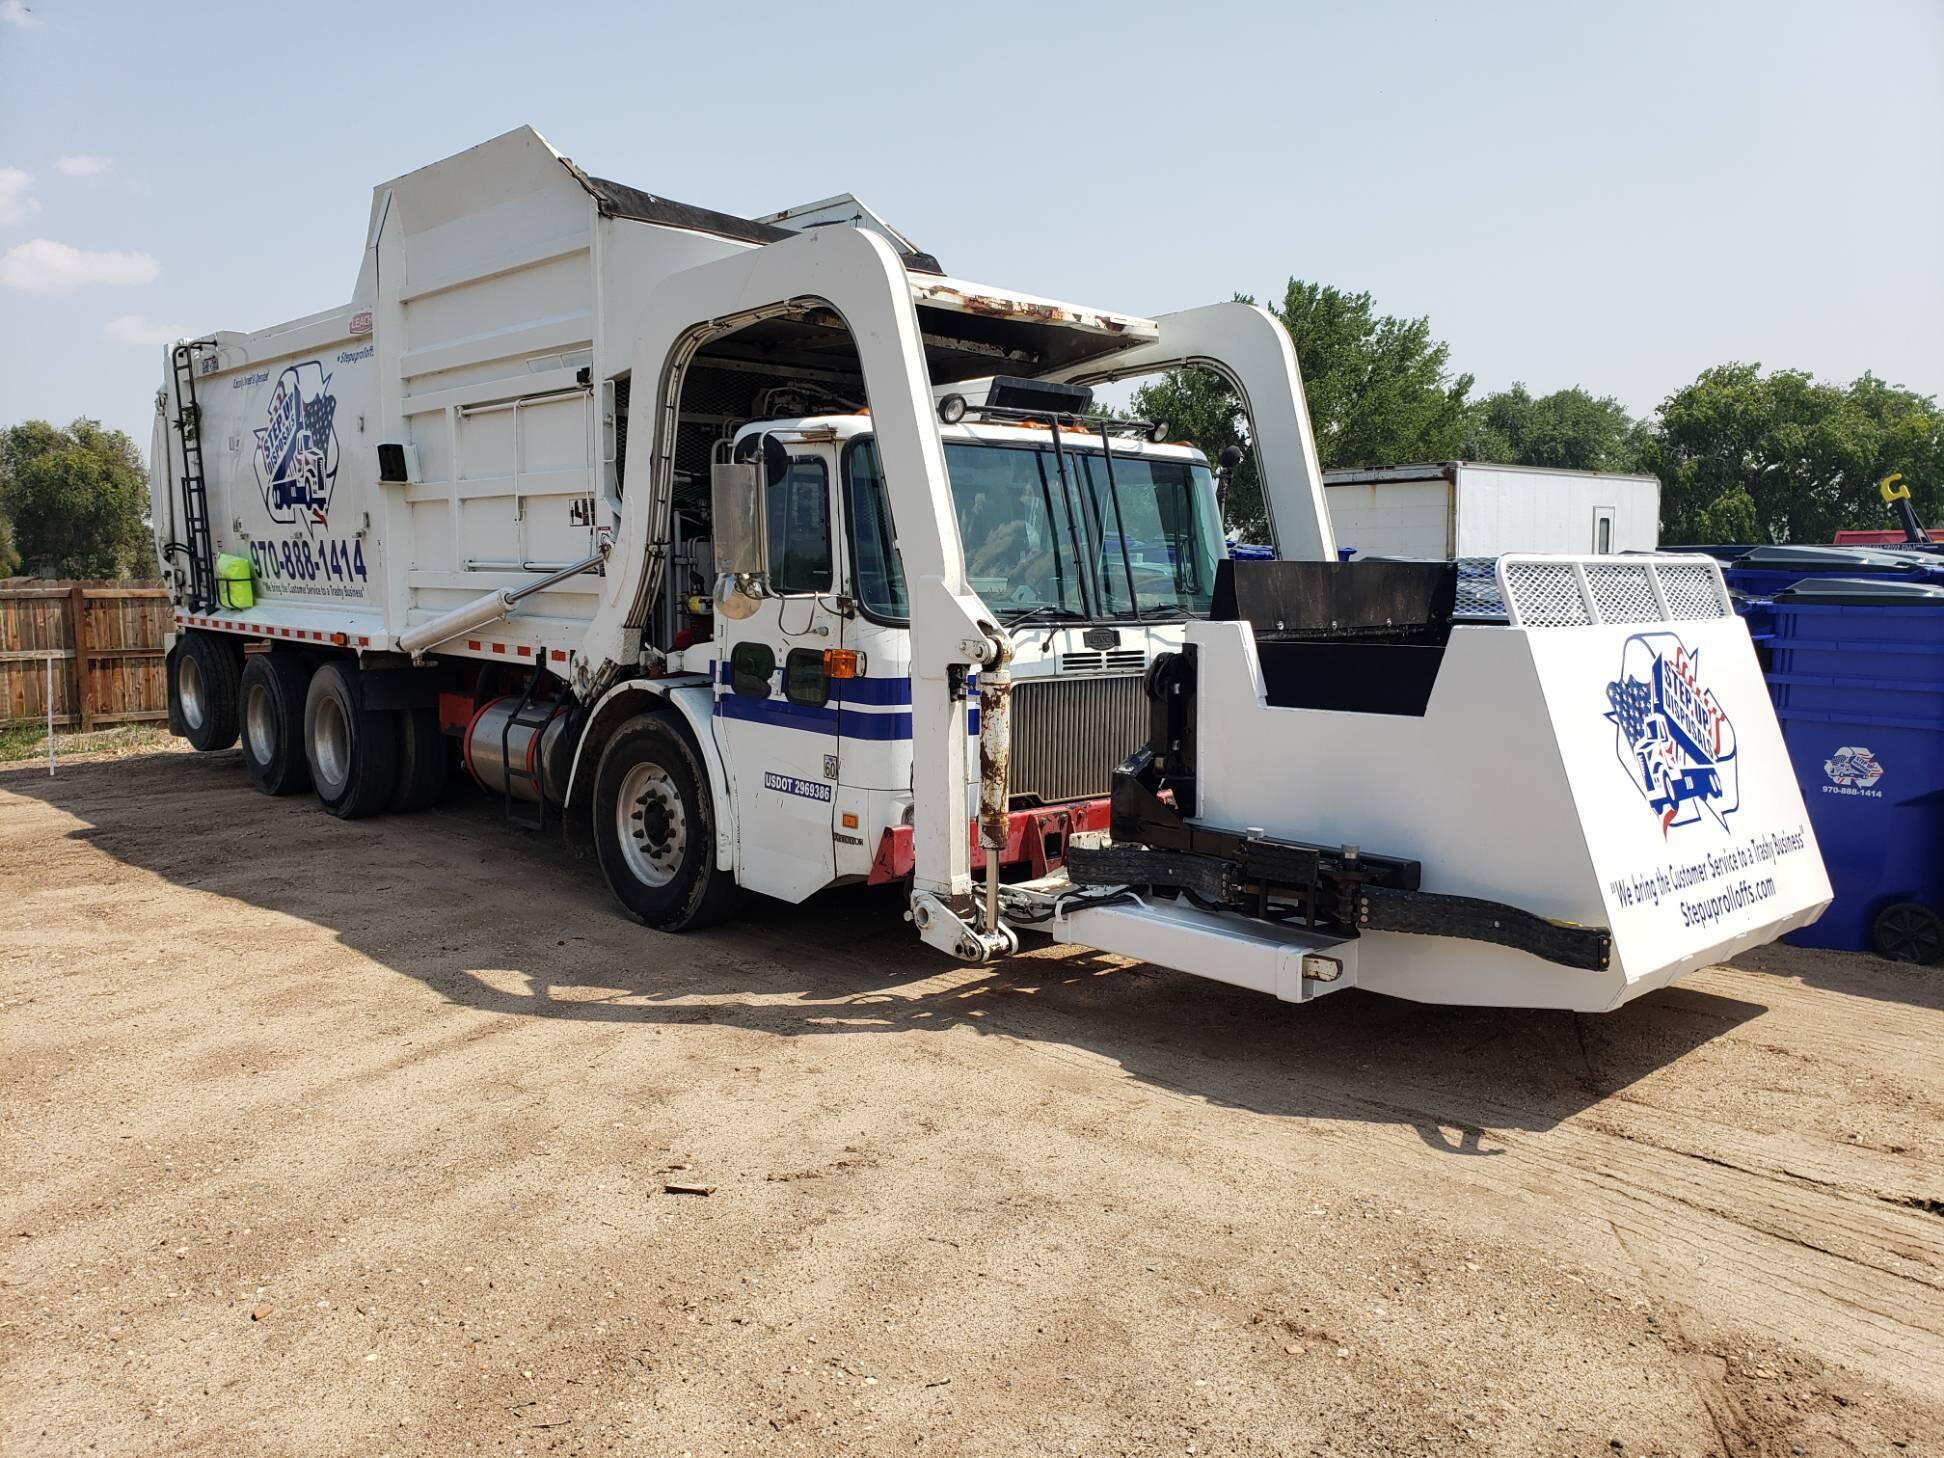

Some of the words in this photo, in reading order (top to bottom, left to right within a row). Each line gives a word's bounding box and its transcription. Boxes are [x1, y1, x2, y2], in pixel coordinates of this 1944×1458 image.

[264, 412, 283, 460] STEP
[267, 413, 295, 475] DISPOSALS
[250, 540, 367, 582] 970-888-1414
[1663, 660, 1693, 711] STEP
[1694, 697, 1711, 732] UP
[1664, 687, 1714, 760] DISPOSALS
[825, 761, 836, 778] 60
[765, 773, 793, 792] USDOT
[794, 780, 830, 800] 2969386
[1822, 785, 1882, 798] 970-888-1414
[1707, 847, 1739, 878] Service
[1736, 847, 1748, 868] to
[1747, 847, 1754, 864] a
[1750, 833, 1776, 866] Trashy
[1631, 873, 1659, 907] bring
[1656, 866, 1671, 895] the
[1669, 862, 1708, 890] Customer
[1610, 879, 1633, 908] "We
[1680, 877, 1776, 929] Stepuprolloffs.com
